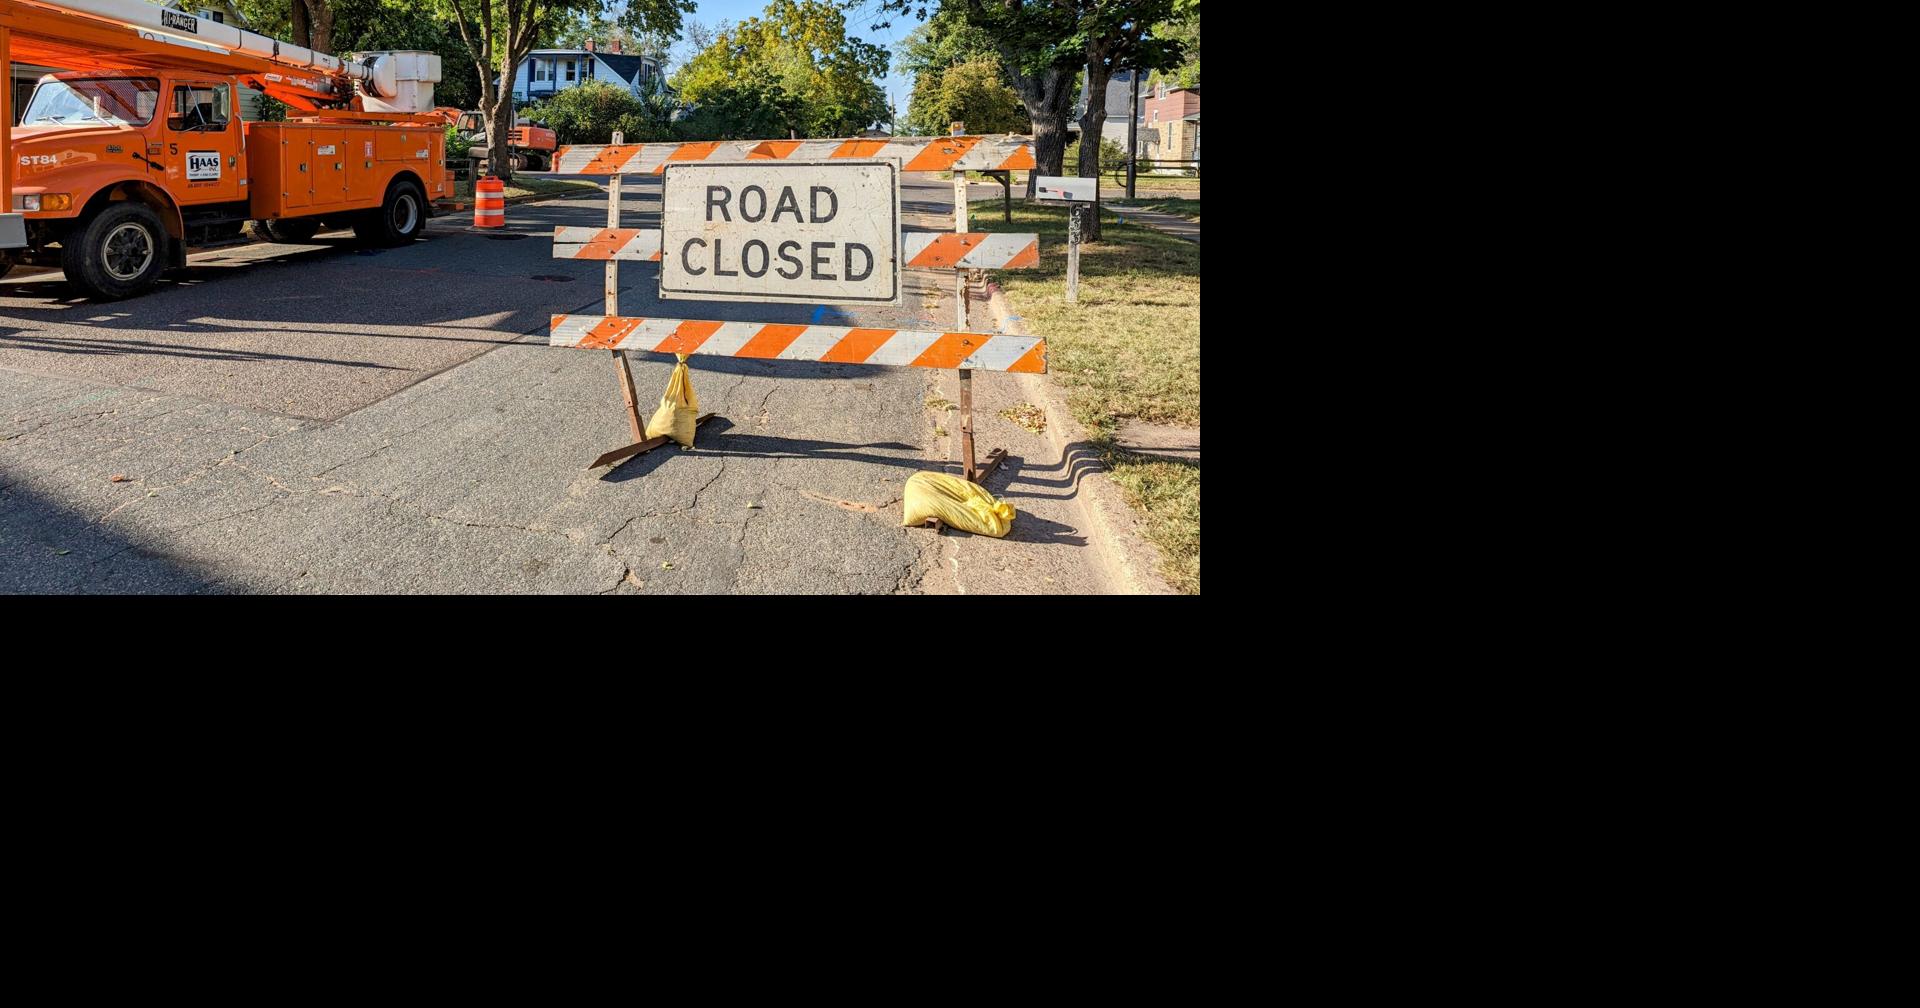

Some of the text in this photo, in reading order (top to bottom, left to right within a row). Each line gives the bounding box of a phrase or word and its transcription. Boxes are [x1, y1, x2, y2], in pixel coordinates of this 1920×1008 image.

[169, 143, 178, 155] 5
[20, 154, 57, 166] ST84
[190, 157, 219, 170] HAAS
[705, 184, 839, 224] ROAD
[681, 237, 874, 282] CLOSED
